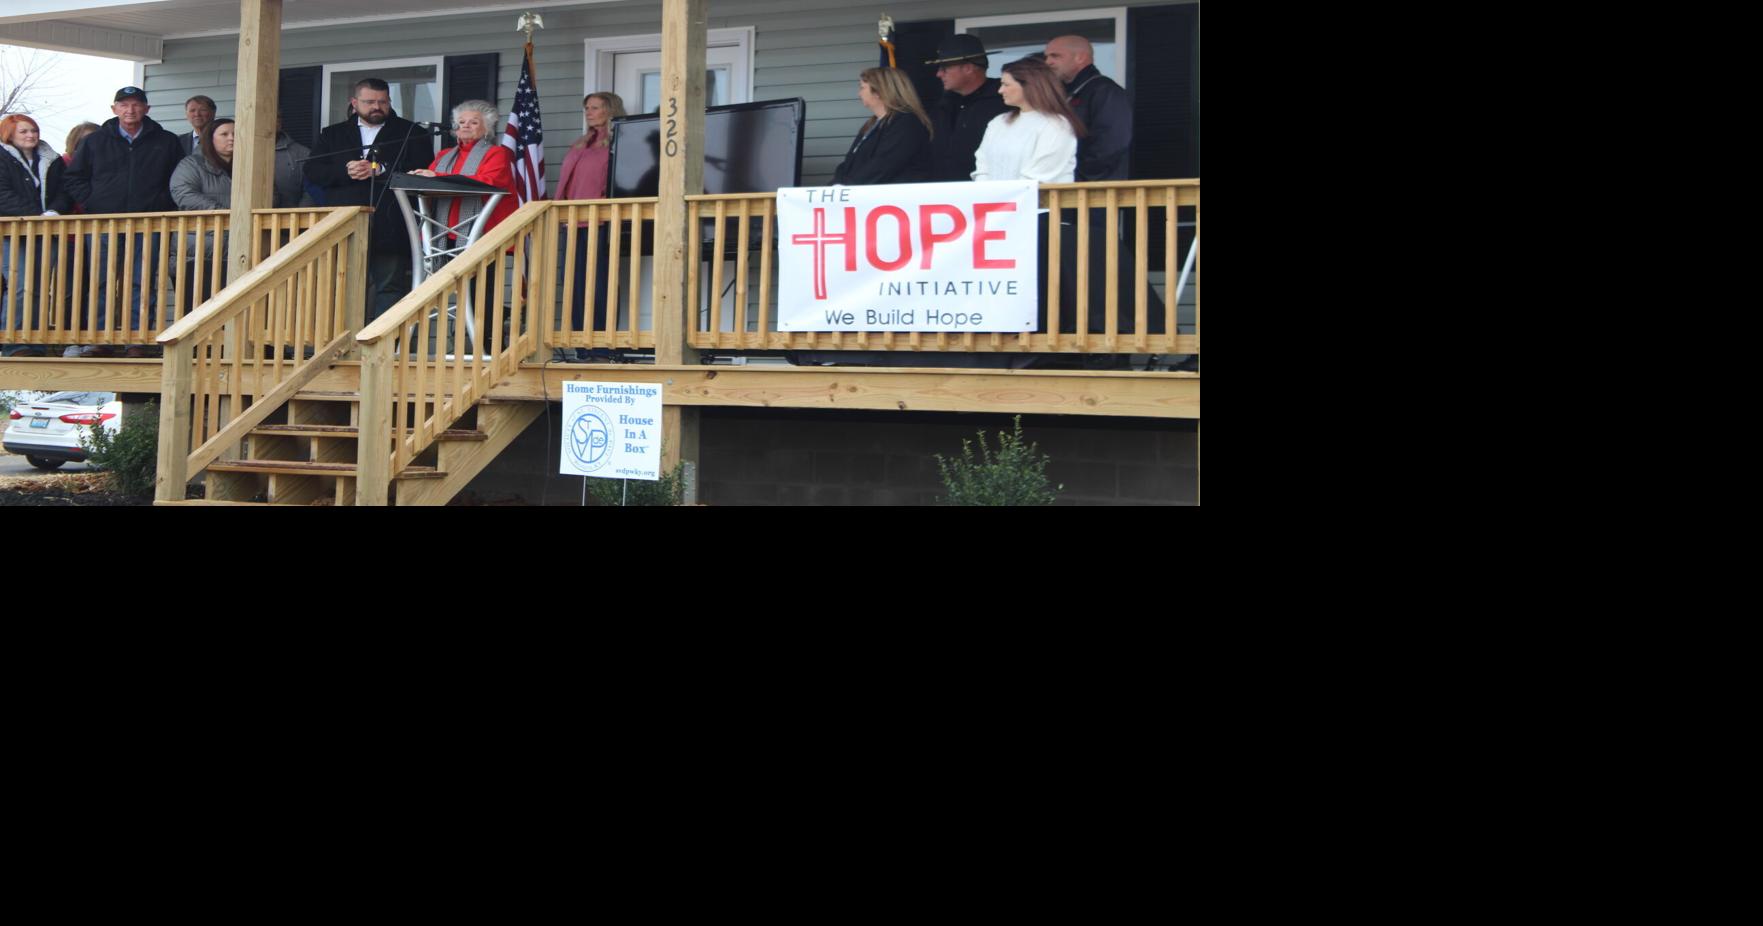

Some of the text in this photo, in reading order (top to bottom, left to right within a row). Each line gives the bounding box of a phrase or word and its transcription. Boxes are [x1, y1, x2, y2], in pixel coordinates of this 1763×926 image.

[665, 97, 677, 157] 320
[806, 189, 851, 203] THE
[792, 202, 1017, 299] HOPE
[879, 281, 1018, 296] INITIATIVE
[825, 309, 983, 328] We Build Hope
[567, 384, 657, 397] Home Furnishings
[586, 395, 636, 405] Provided By
[619, 415, 654, 425] House
[624, 429, 647, 440] In A
